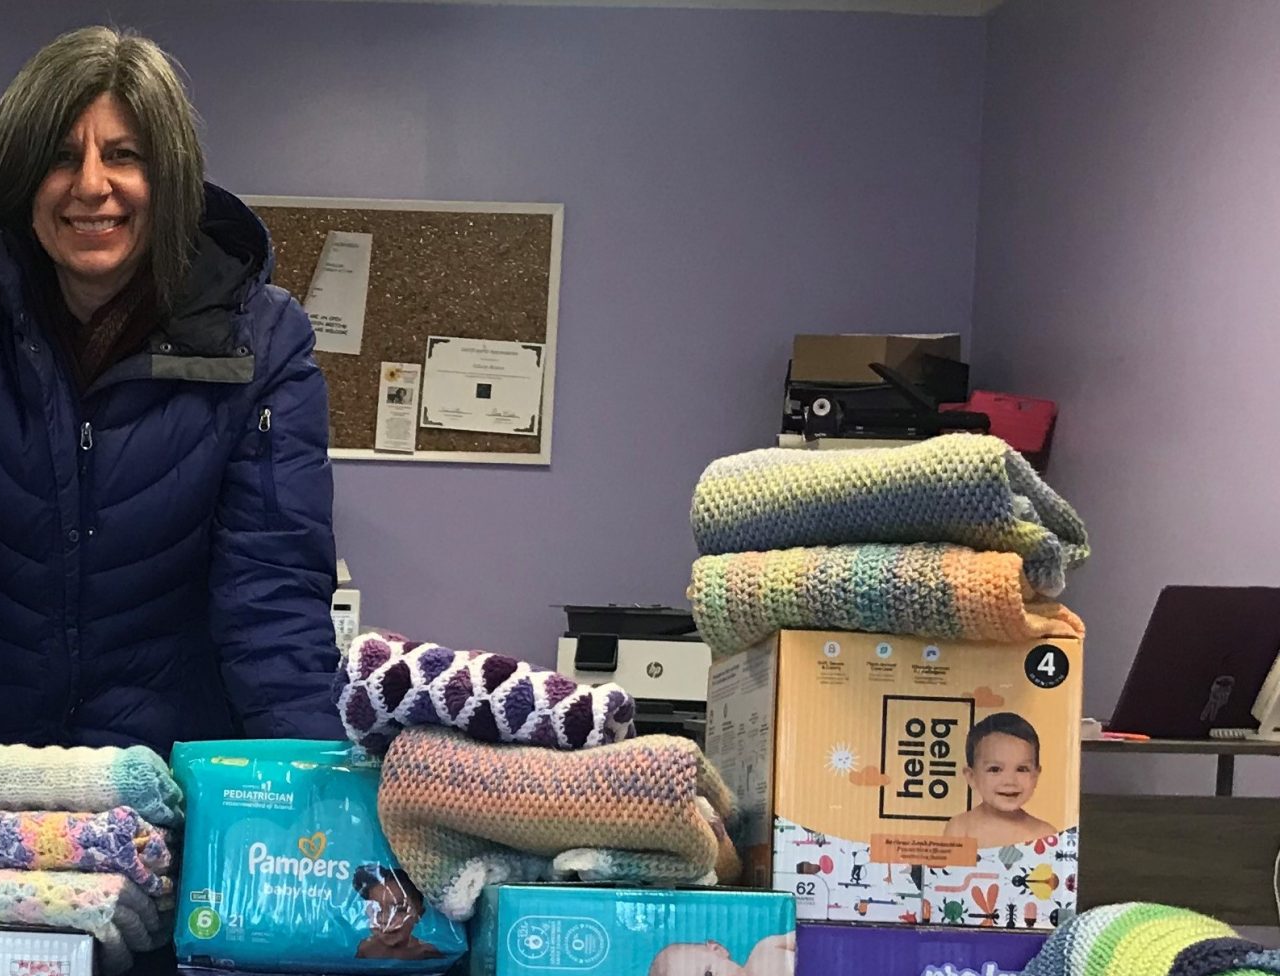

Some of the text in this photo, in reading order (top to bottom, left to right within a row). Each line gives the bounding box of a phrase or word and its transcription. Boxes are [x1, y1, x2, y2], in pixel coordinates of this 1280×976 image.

[1037, 652, 1056, 676] 4
[897, 717, 926, 799] hello
[928, 718, 958, 799] bello
[224, 789, 293, 803] PEDIATRICIAN
[249, 842, 350, 881] Pampers
[264, 881, 331, 900] baby-dry
[796, 881, 815, 896] 62
[197, 910, 244, 928] 6 21
